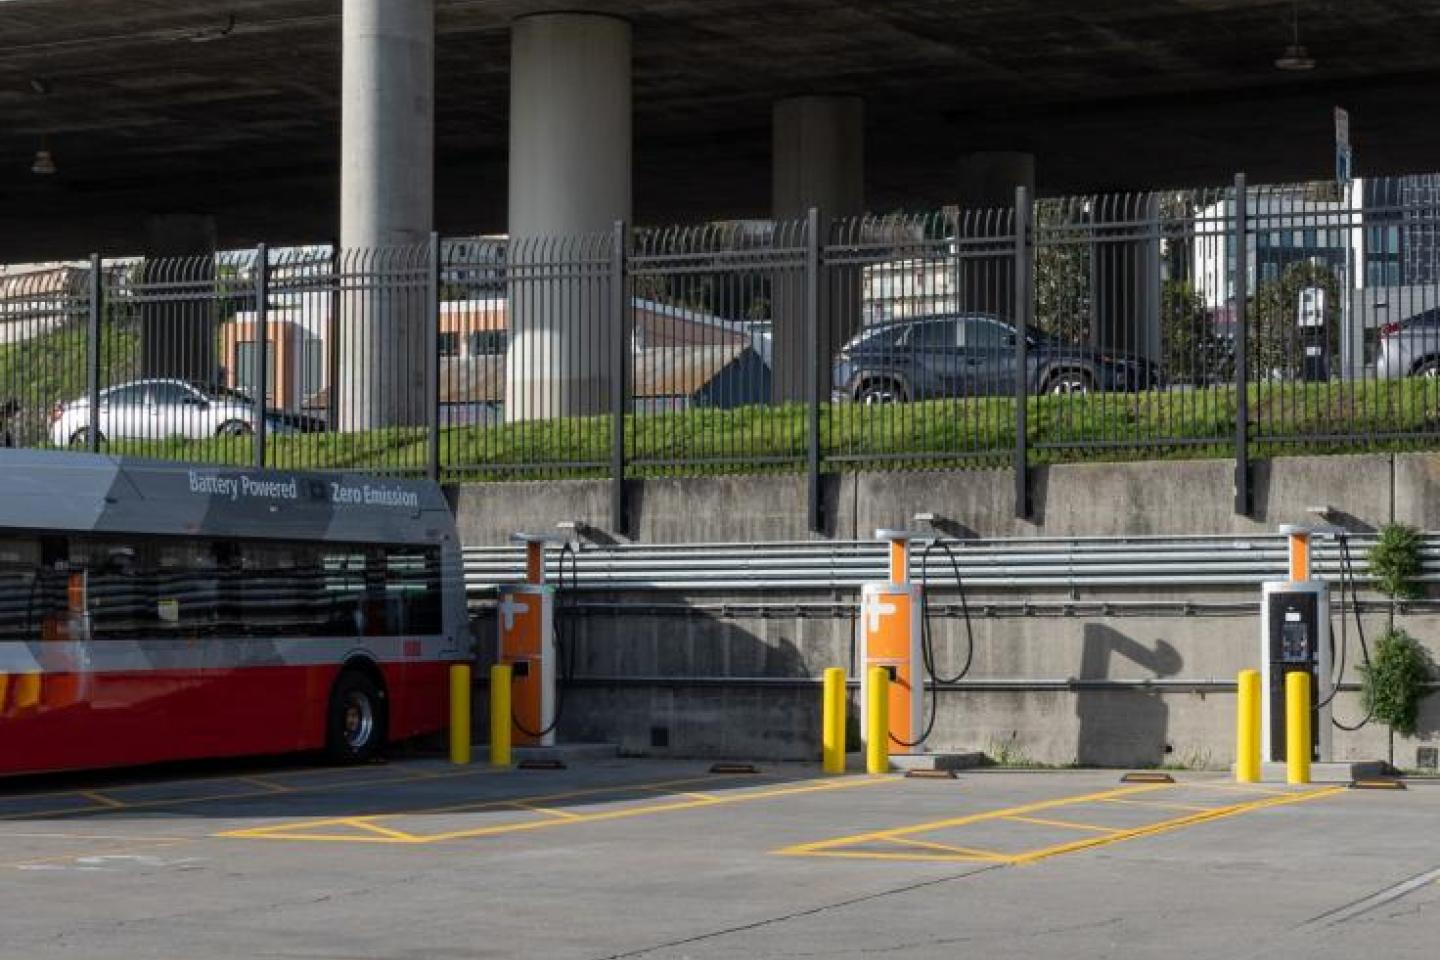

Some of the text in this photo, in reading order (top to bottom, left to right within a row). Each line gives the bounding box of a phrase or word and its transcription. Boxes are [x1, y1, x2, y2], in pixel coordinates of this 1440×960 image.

[189, 471, 297, 500] Battery Powered
[331, 482, 418, 506] Zero Emission
